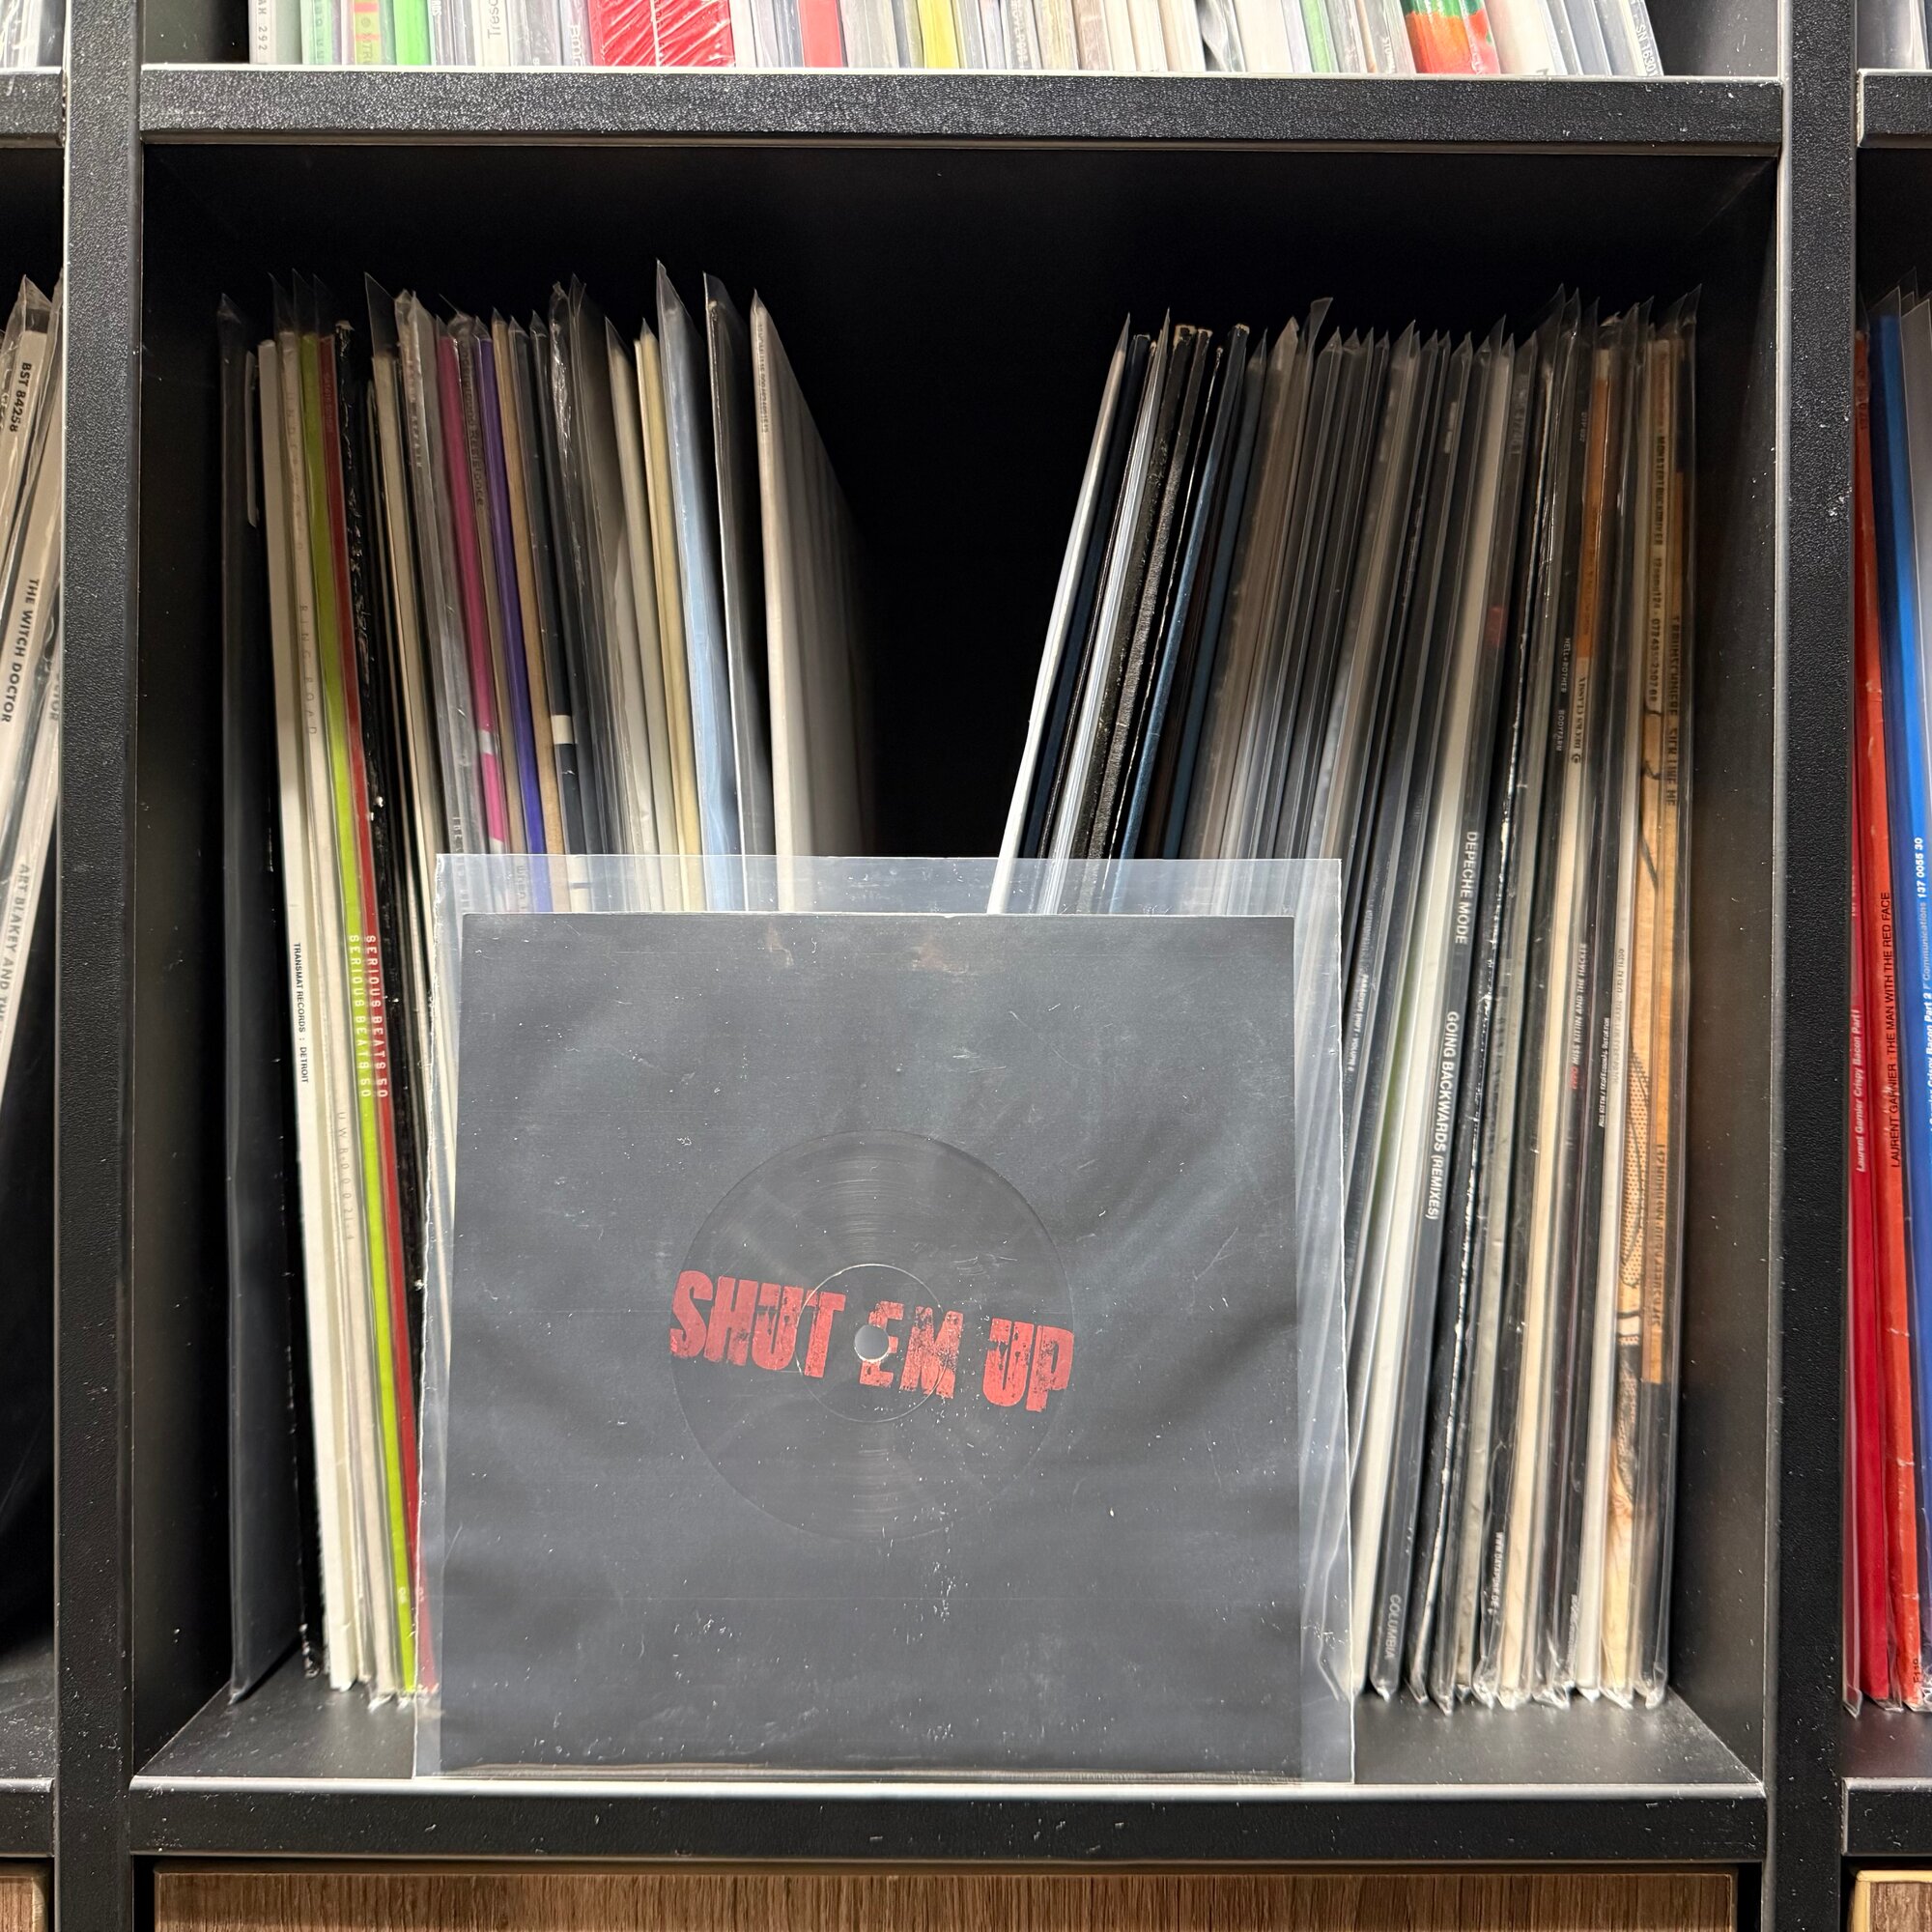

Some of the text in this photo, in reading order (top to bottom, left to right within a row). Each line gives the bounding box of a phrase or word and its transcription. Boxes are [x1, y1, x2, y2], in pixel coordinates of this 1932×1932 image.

[258, 26, 269, 50] 292
[1635, 25, 1648, 42] SN
[9, 362, 32, 433] BST 84258
[1, 579, 40, 724] THE WITCH DOCTOR
[1555, 709, 1566, 752] BODYFARM
[1915, 837, 1924, 850] 30
[17, 864, 32, 891] ART
[1916, 853, 1926, 877] 0055
[1918, 880, 1927, 897] 137
[6, 897, 26, 952] BLAKEY
[0, 957, 14, 989] AND
[295, 942, 303, 989] TRANSMAT
[349, 933, 365, 1005] SERIOUS
[297, 990, 305, 1033] RECORDS
[365, 935, 388, 1098] SERIOUS BEATS 50
[1573, 1015, 1581, 1042] KITTIN
[1880, 892, 1900, 1168] LAURENT GARNIER THE MAN WITH THE RED FACE
[1923, 1002, 1932, 1022] Part
[355, 1014, 370, 1067] BEATS
[1852, 1037, 1862, 1065] Bacon
[299, 1046, 308, 1083] DETROIT
[1852, 1066, 1863, 1096] Crispy
[1854, 1099, 1864, 1133] Garnier
[1855, 1135, 1865, 1172] Laurent
[1384, 832, 1479, 1660] DEPECHE MODE GOING BACKWARDS (REMIXES) COLUMBIA
[669, 1270, 1075, 1413] SHUT EM UP
